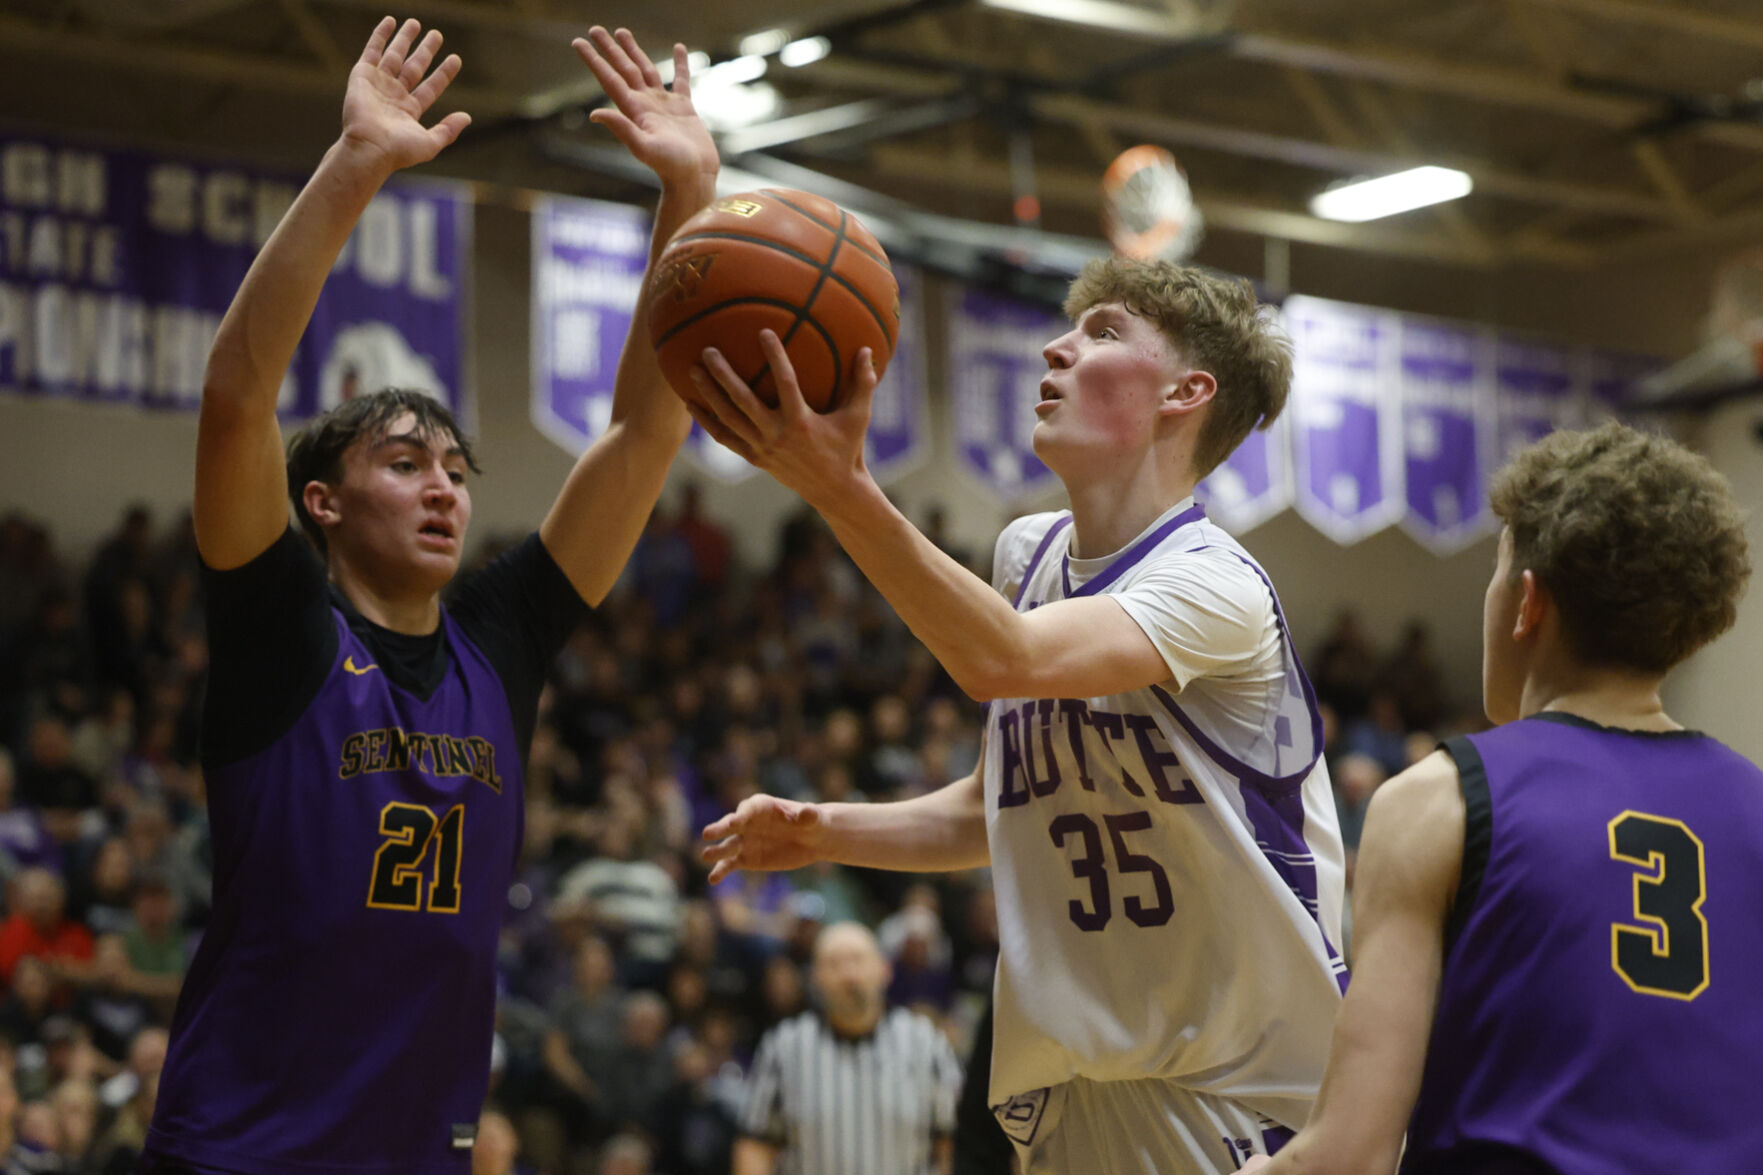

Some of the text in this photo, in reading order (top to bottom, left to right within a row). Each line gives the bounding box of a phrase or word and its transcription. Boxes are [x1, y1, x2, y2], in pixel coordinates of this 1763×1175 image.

[339, 726, 502, 795] SENTINEL
[998, 698, 1206, 810] BUTTE
[366, 800, 465, 914] 21
[1049, 811, 1175, 932] 35
[1607, 809, 1710, 1002] 3
